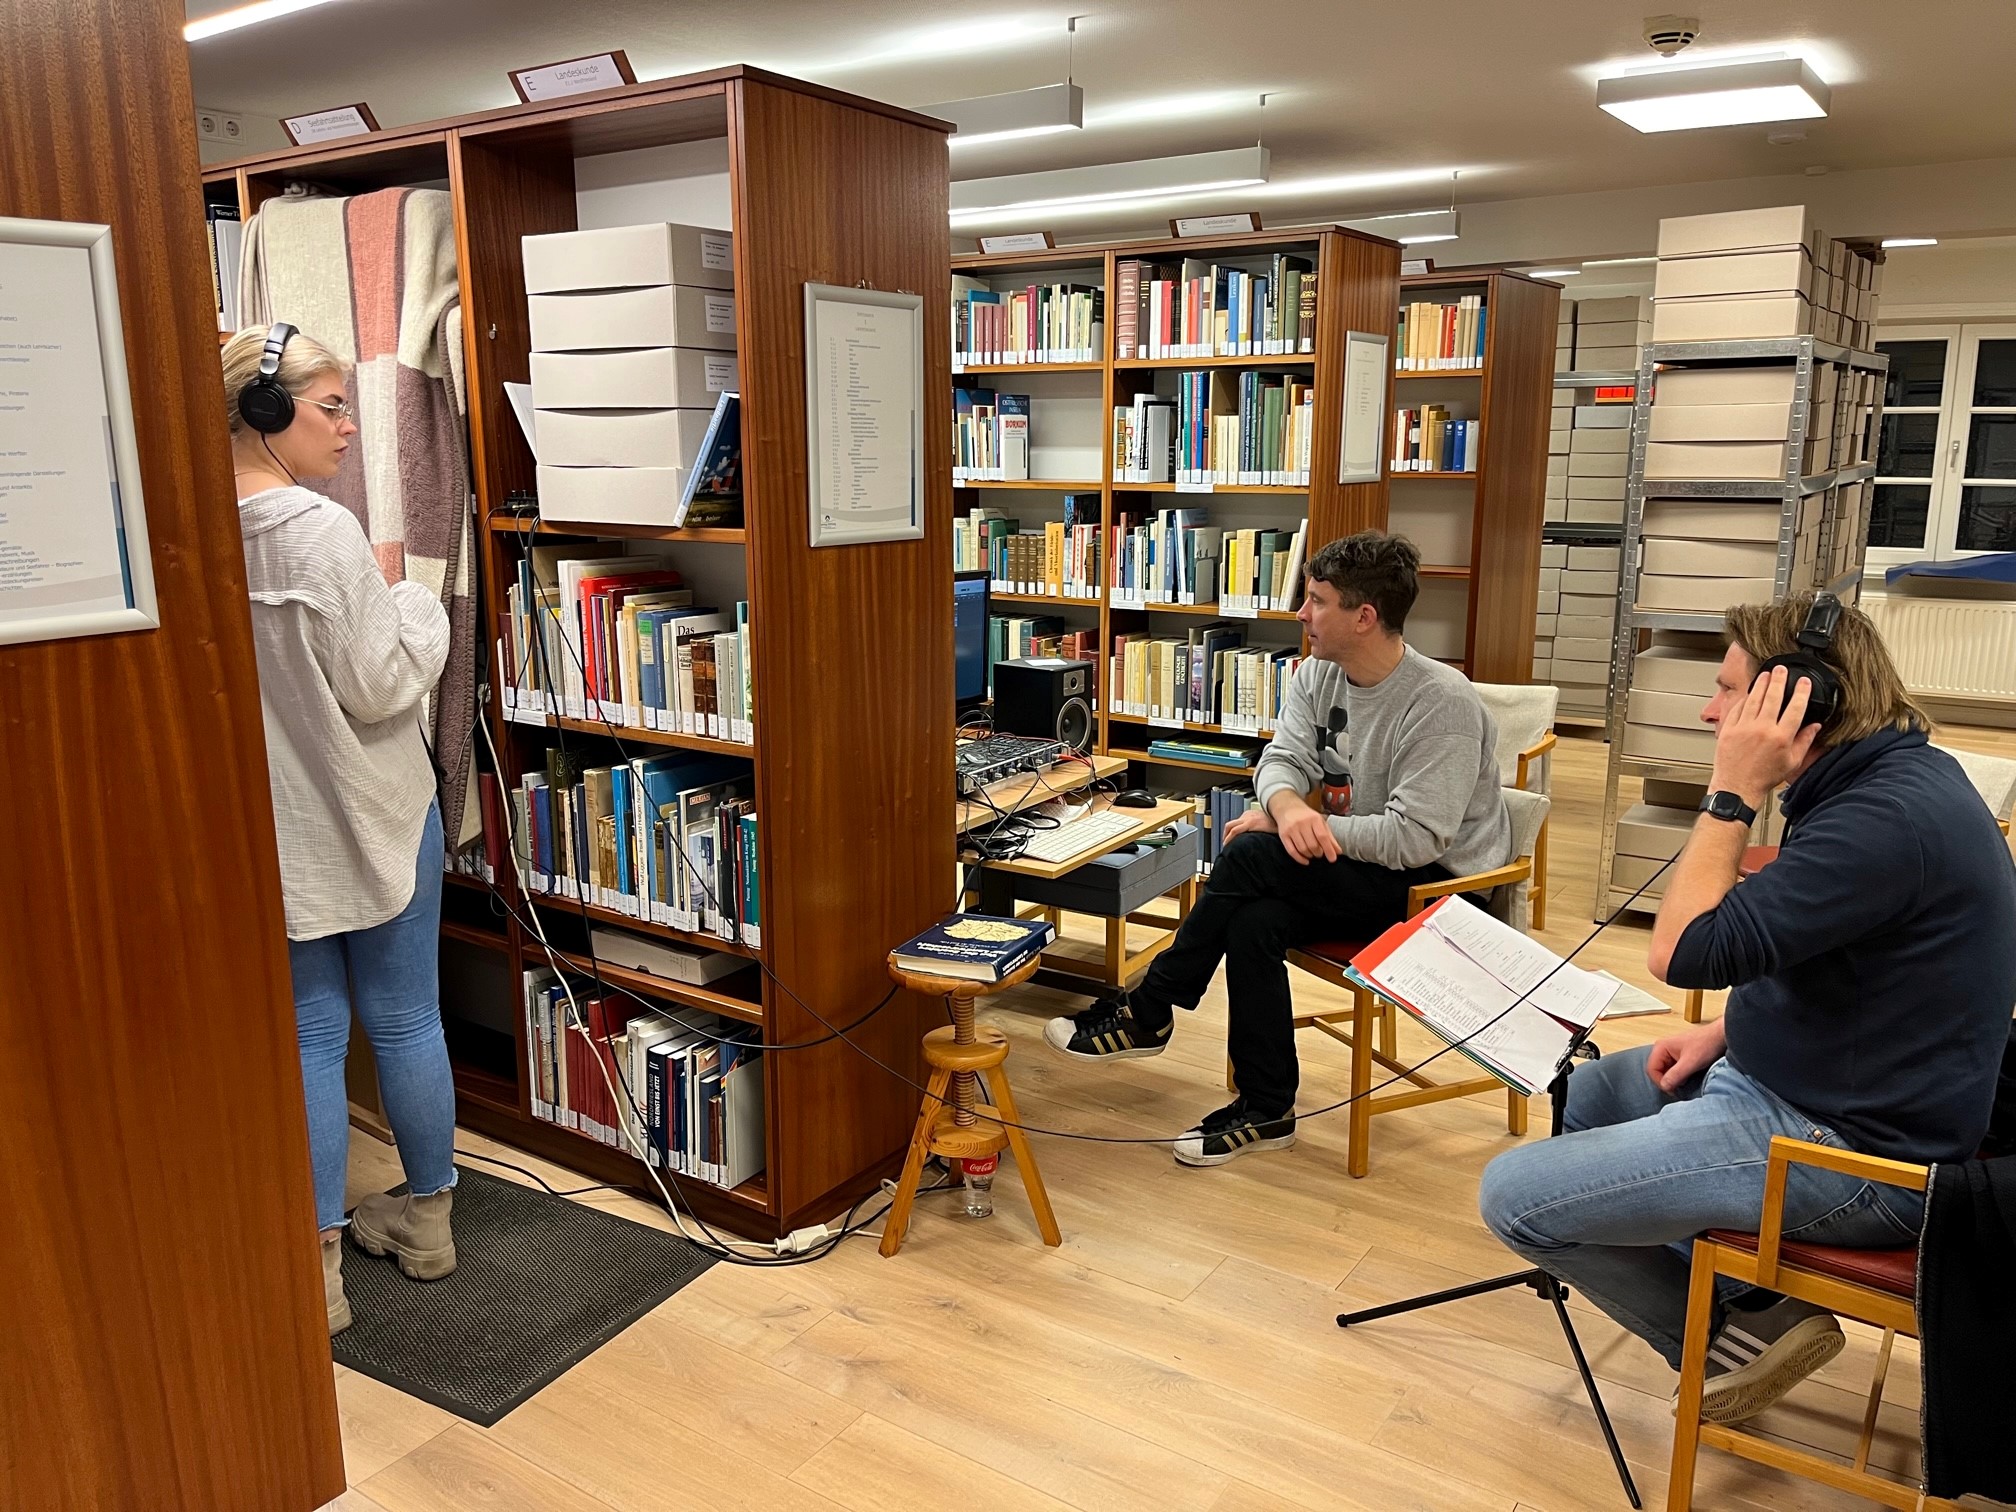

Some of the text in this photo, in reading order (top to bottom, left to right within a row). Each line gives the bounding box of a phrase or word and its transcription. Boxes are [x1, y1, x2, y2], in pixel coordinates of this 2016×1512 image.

[524, 65, 599, 91] E Landeskunde
[291, 122, 302, 135] D
[1181, 221, 1188, 229] E
[677, 626, 695, 636] Das
[970, 1162, 993, 1172] Coca-Cola
